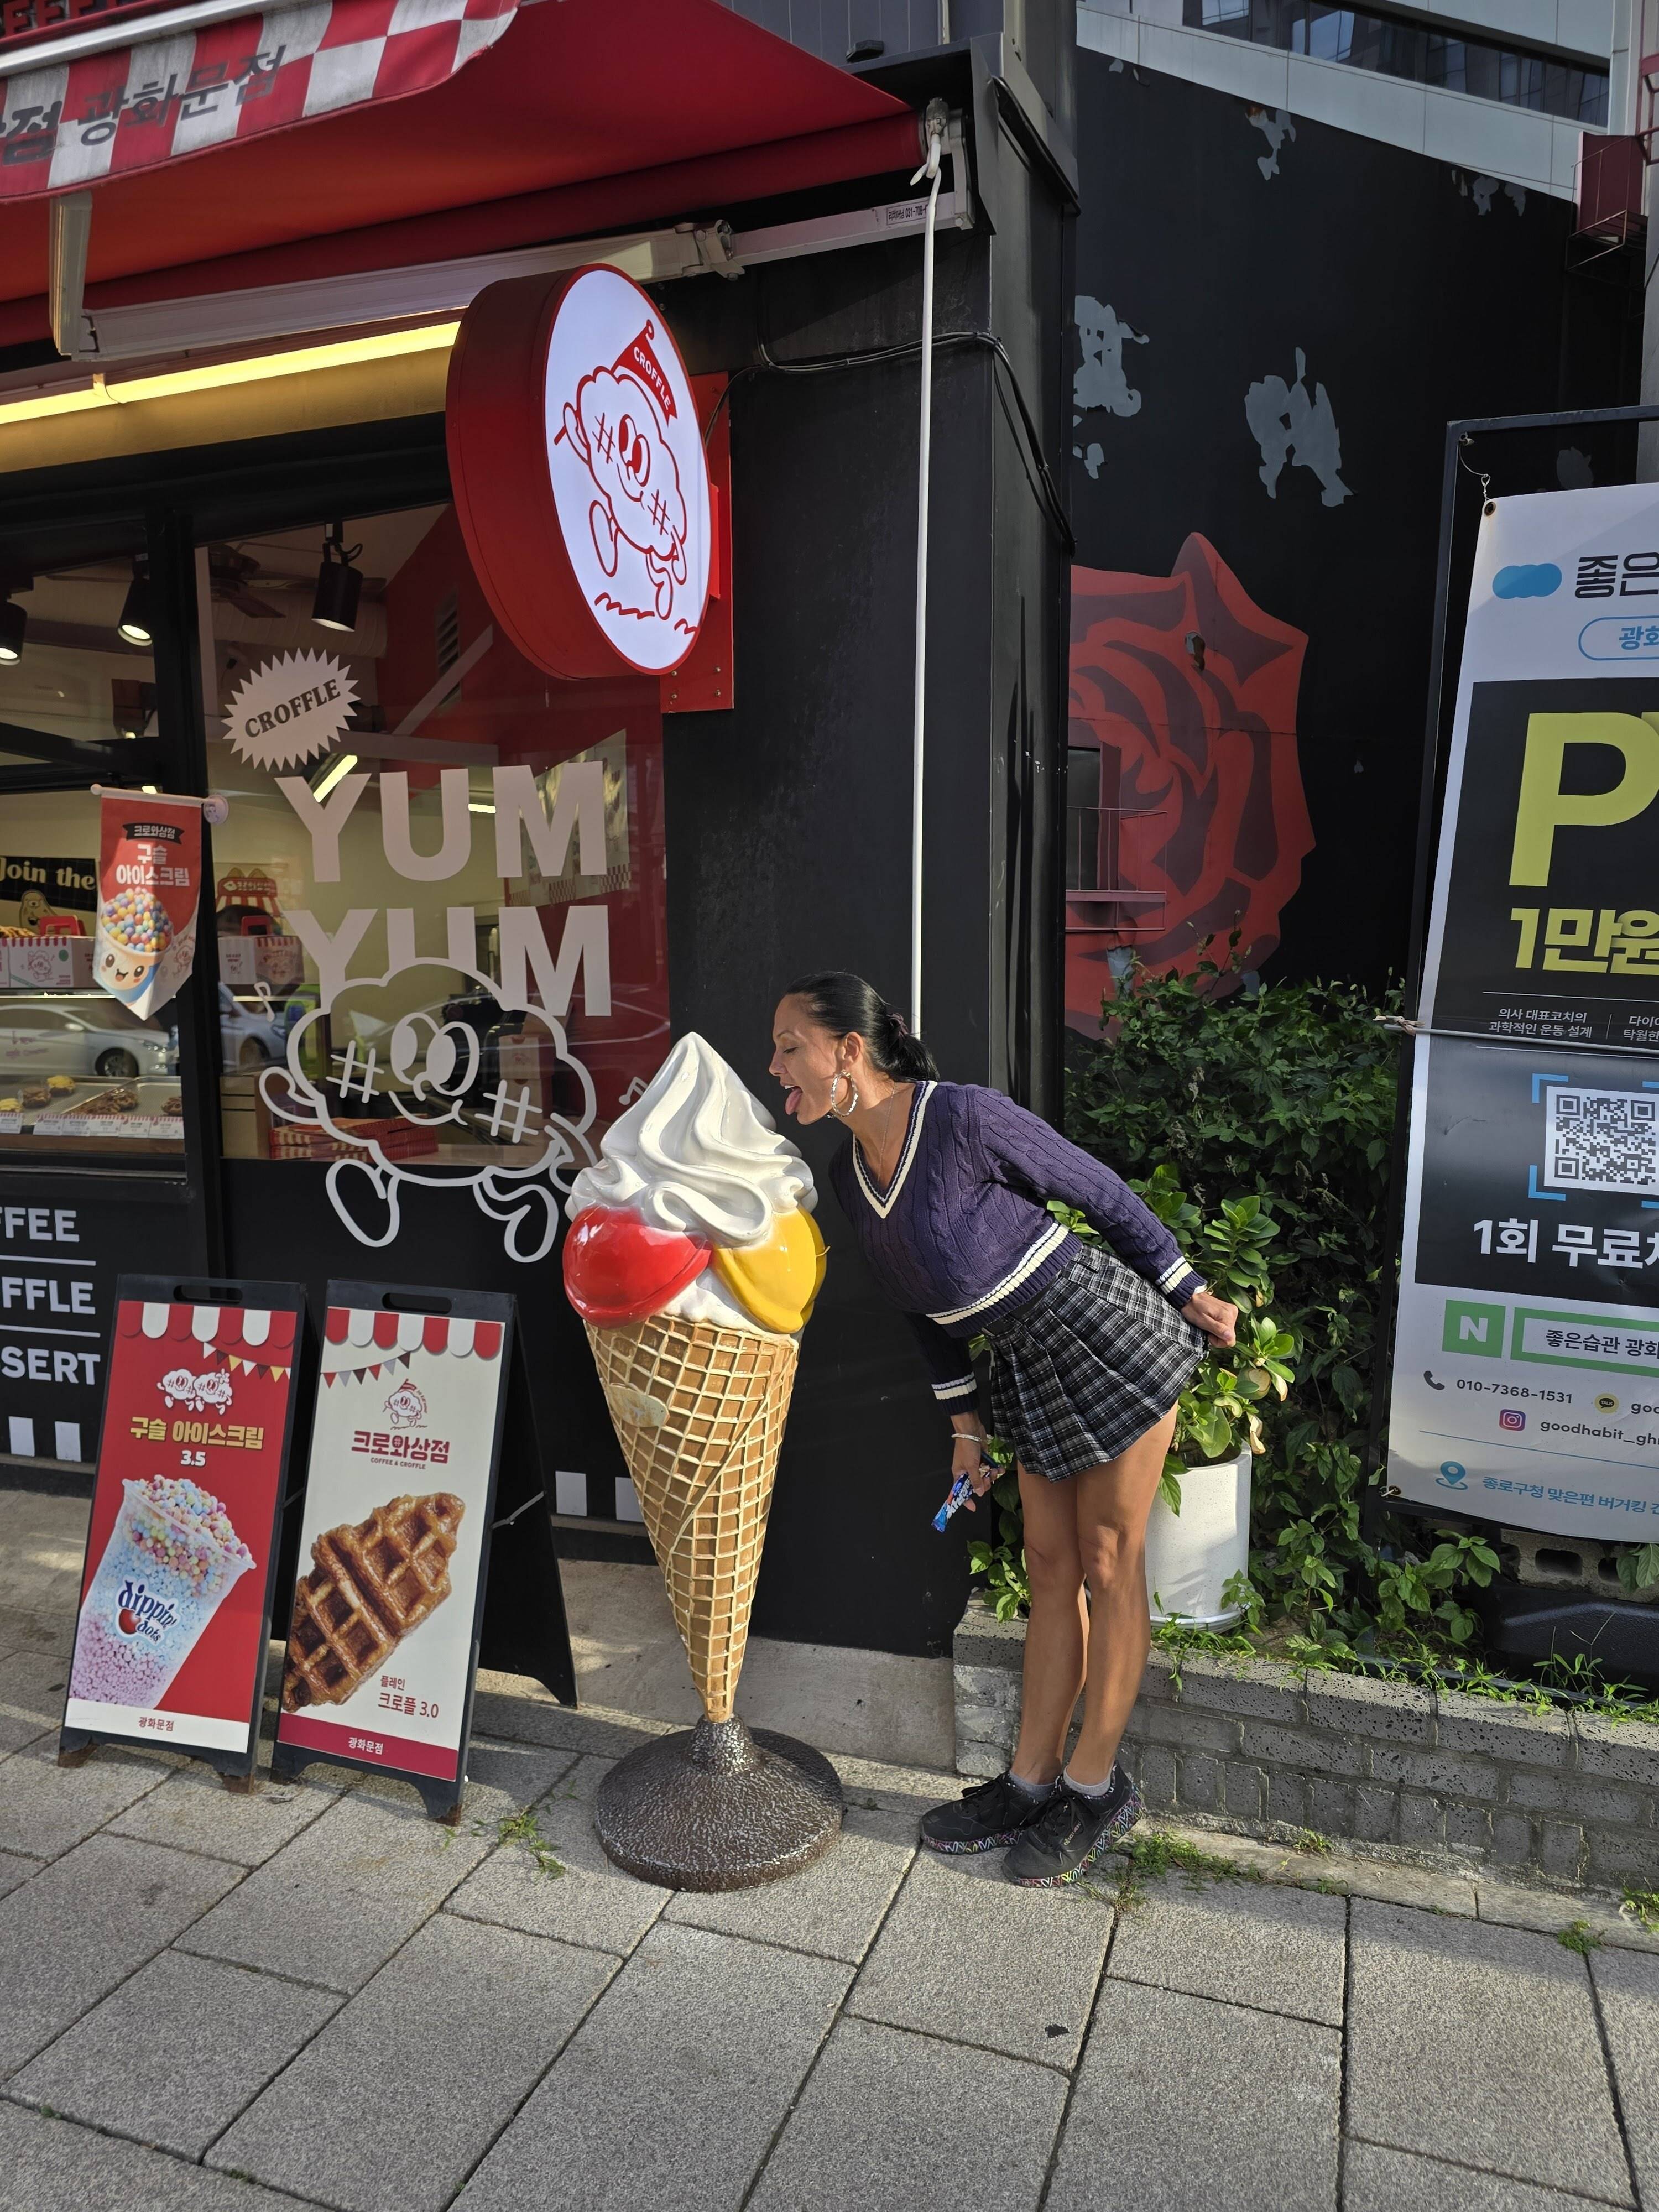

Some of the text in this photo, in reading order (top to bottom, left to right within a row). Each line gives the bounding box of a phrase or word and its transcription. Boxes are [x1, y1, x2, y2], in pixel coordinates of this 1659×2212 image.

[81, 44, 286, 146] 광화문점
[634, 347, 671, 410] CROFFLE
[1575, 552, 1659, 598] 좋은
[245, 687, 341, 738] CROFFLE
[1509, 711, 1659, 887] P
[134, 825, 176, 839] 크로와상점
[274, 761, 607, 883] YUM
[137, 844, 167, 864] 구슬
[56, 867, 96, 890] the
[116, 864, 190, 886] 아이스크림
[1510, 907, 1659, 975] 1만원
[281, 905, 612, 1016] YUM
[1498, 1008, 1587, 1023] 의사 대표코치의
[1489, 1021, 1593, 1038] 과학적인 운동 설계
[1624, 1029, 1659, 1042] 탁월한
[0, 1207, 80, 1242] FEE
[1474, 1218, 1538, 1263] 1회
[1459, 1316, 1488, 1342] N
[1546, 1329, 1620, 1354] 좋은습관
[1457, 1379, 1572, 1404] 010-7368-1531
[130, 1416, 264, 1450] 구슬 아이스크림
[1540, 1421, 1659, 1446] goodhabit_gh
[180, 1449, 206, 1467] 3.5
[351, 1430, 450, 1464] 크로와상점
[371, 1457, 393, 1465] COFFEE
[400, 1461, 426, 1469] CROFFLE
[1483, 1476, 1544, 1499] 종로구청
[1548, 1488, 1594, 1507] 맞은편
[1598, 1496, 1646, 1513] 버거킹
[137, 1620, 161, 1642] dots
[380, 1675, 405, 1691] 플레인
[378, 1692, 439, 1718] 크로플 3.0
[138, 1716, 174, 1732] 광화문점
[348, 1737, 384, 1755] 광화문점
